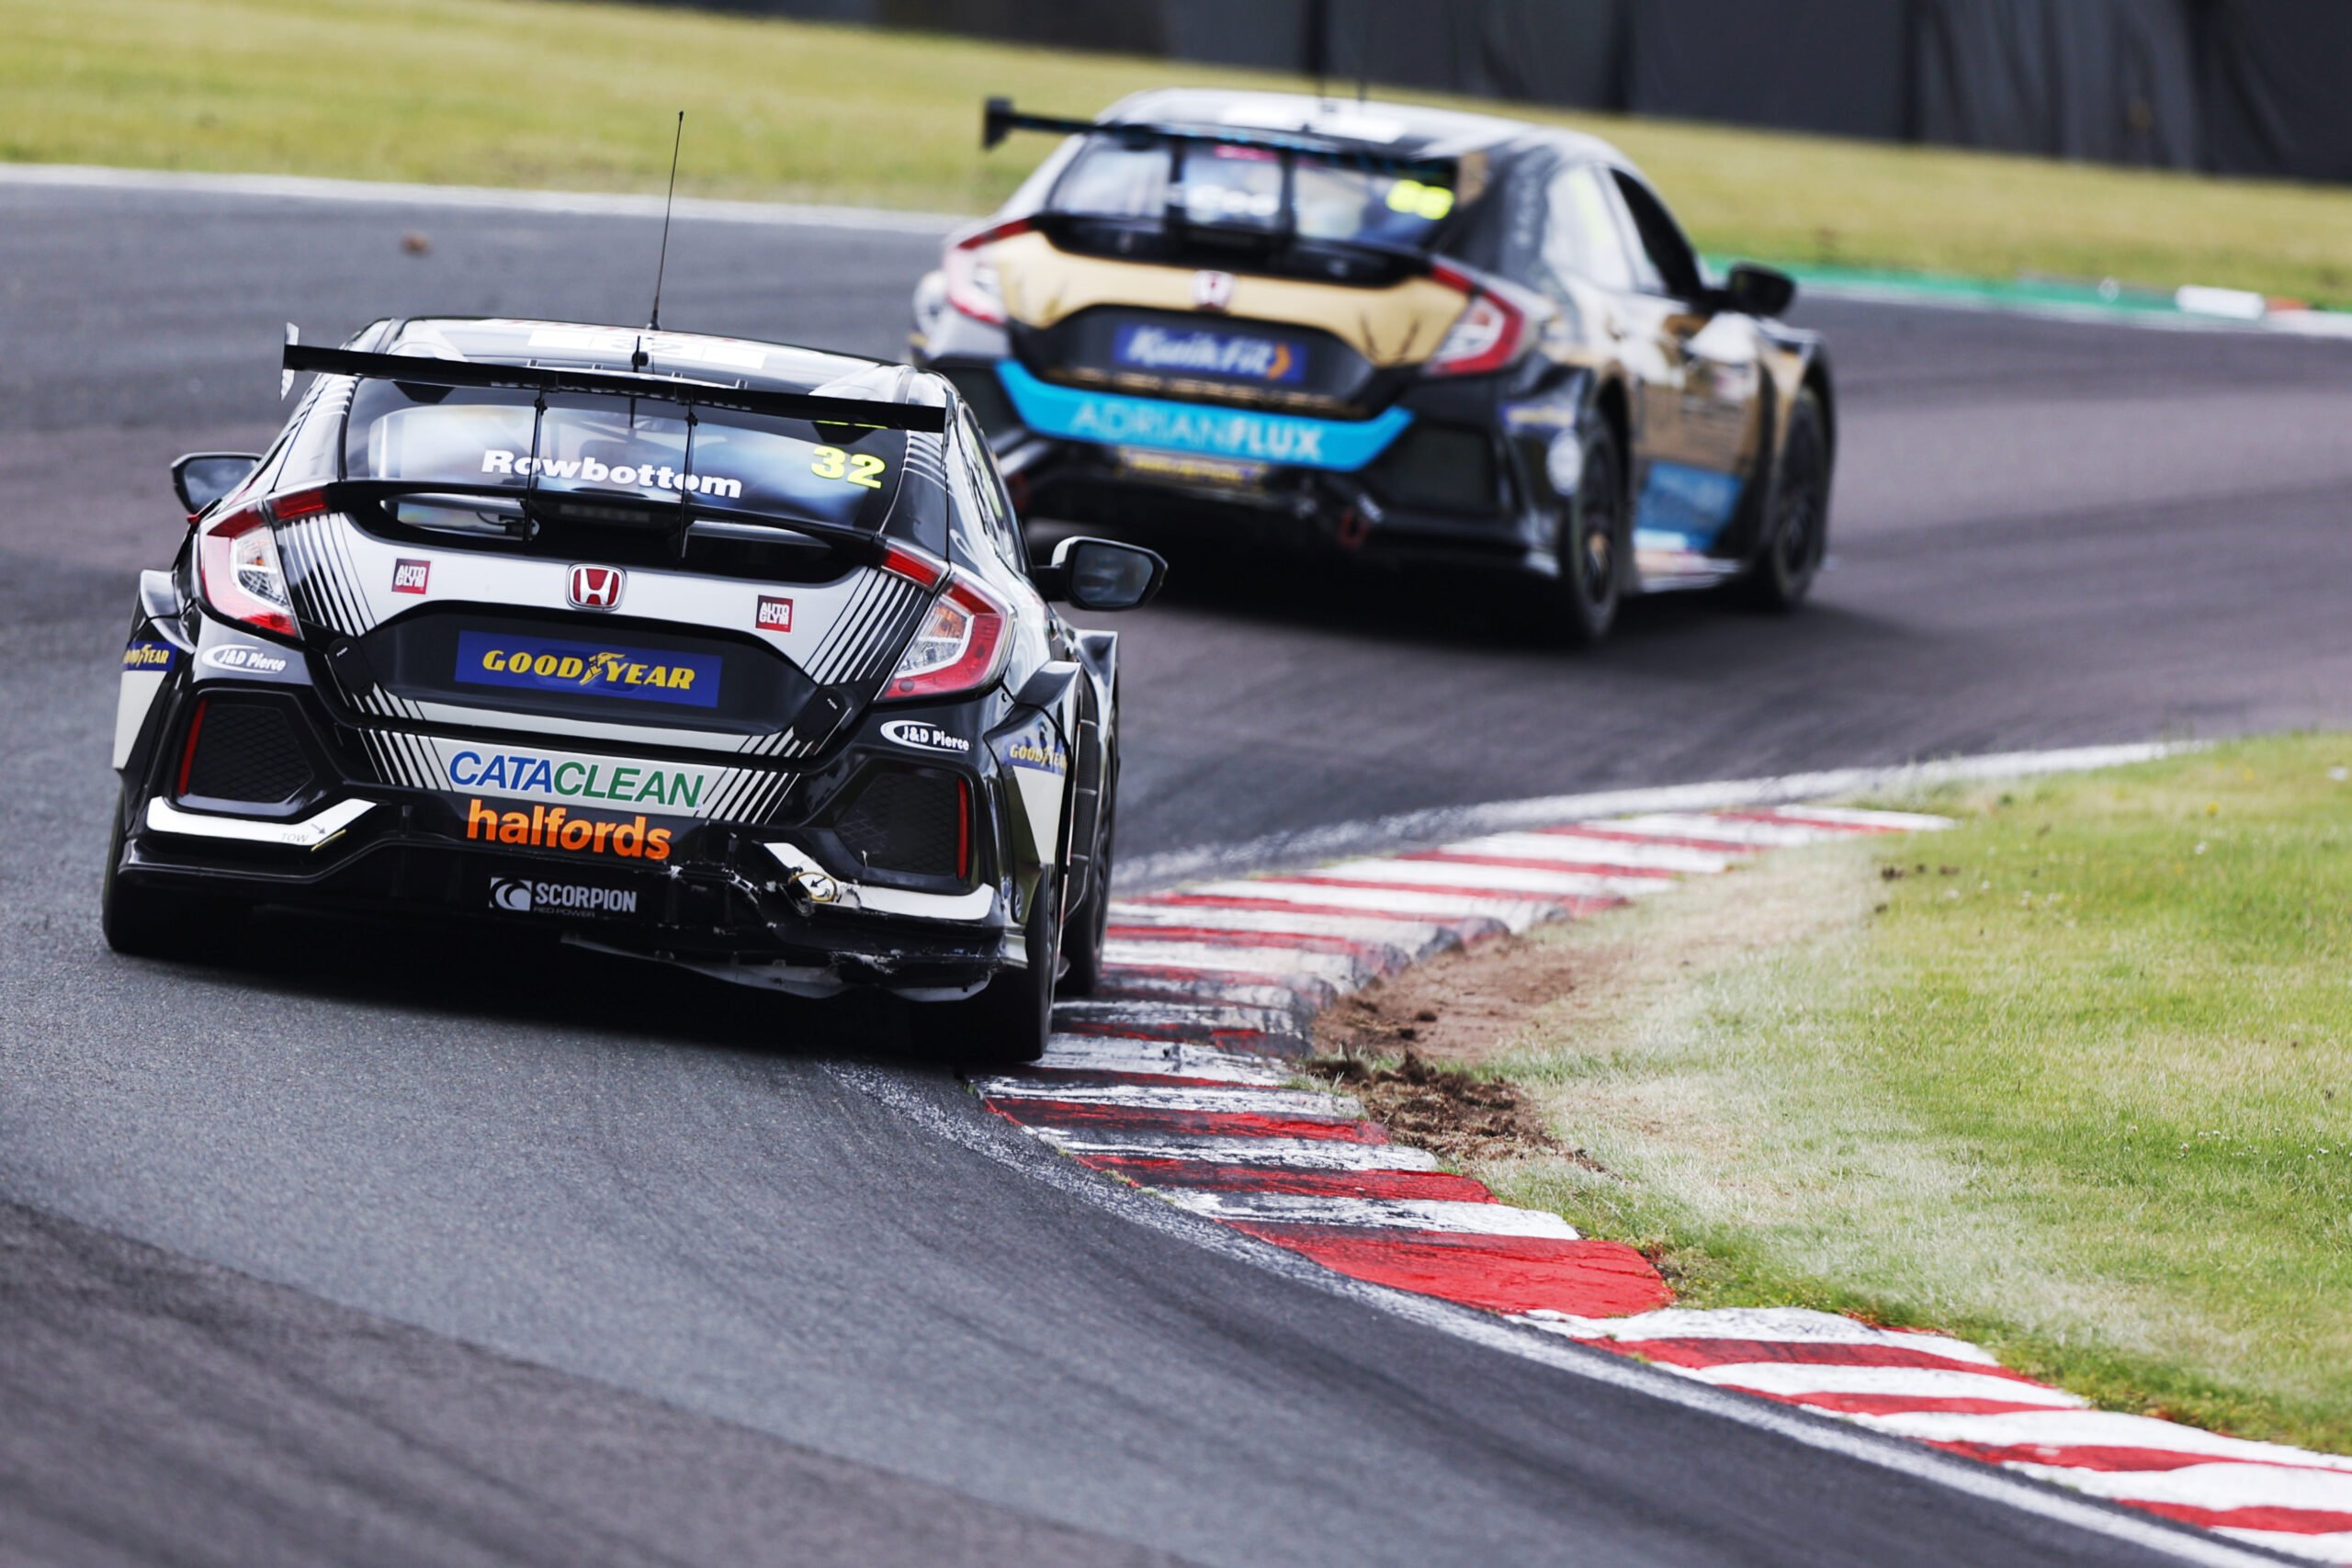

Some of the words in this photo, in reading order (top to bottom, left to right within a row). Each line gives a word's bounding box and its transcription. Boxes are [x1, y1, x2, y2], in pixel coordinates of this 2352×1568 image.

[481, 449, 742, 499] Rowbottom
[811, 446, 886, 490] 32
[397, 565, 427, 578] AUTO
[760, 602, 790, 615] AUTO
[218, 649, 246, 666] J&D
[247, 653, 287, 673] Pierce
[482, 649, 695, 690] GOODYEAR
[902, 725, 930, 745] J&D
[933, 729, 970, 752] Pierce
[449, 750, 705, 808] CATACLEAN
[467, 798, 673, 861] halfords
[535, 882, 638, 913] SCORPION
